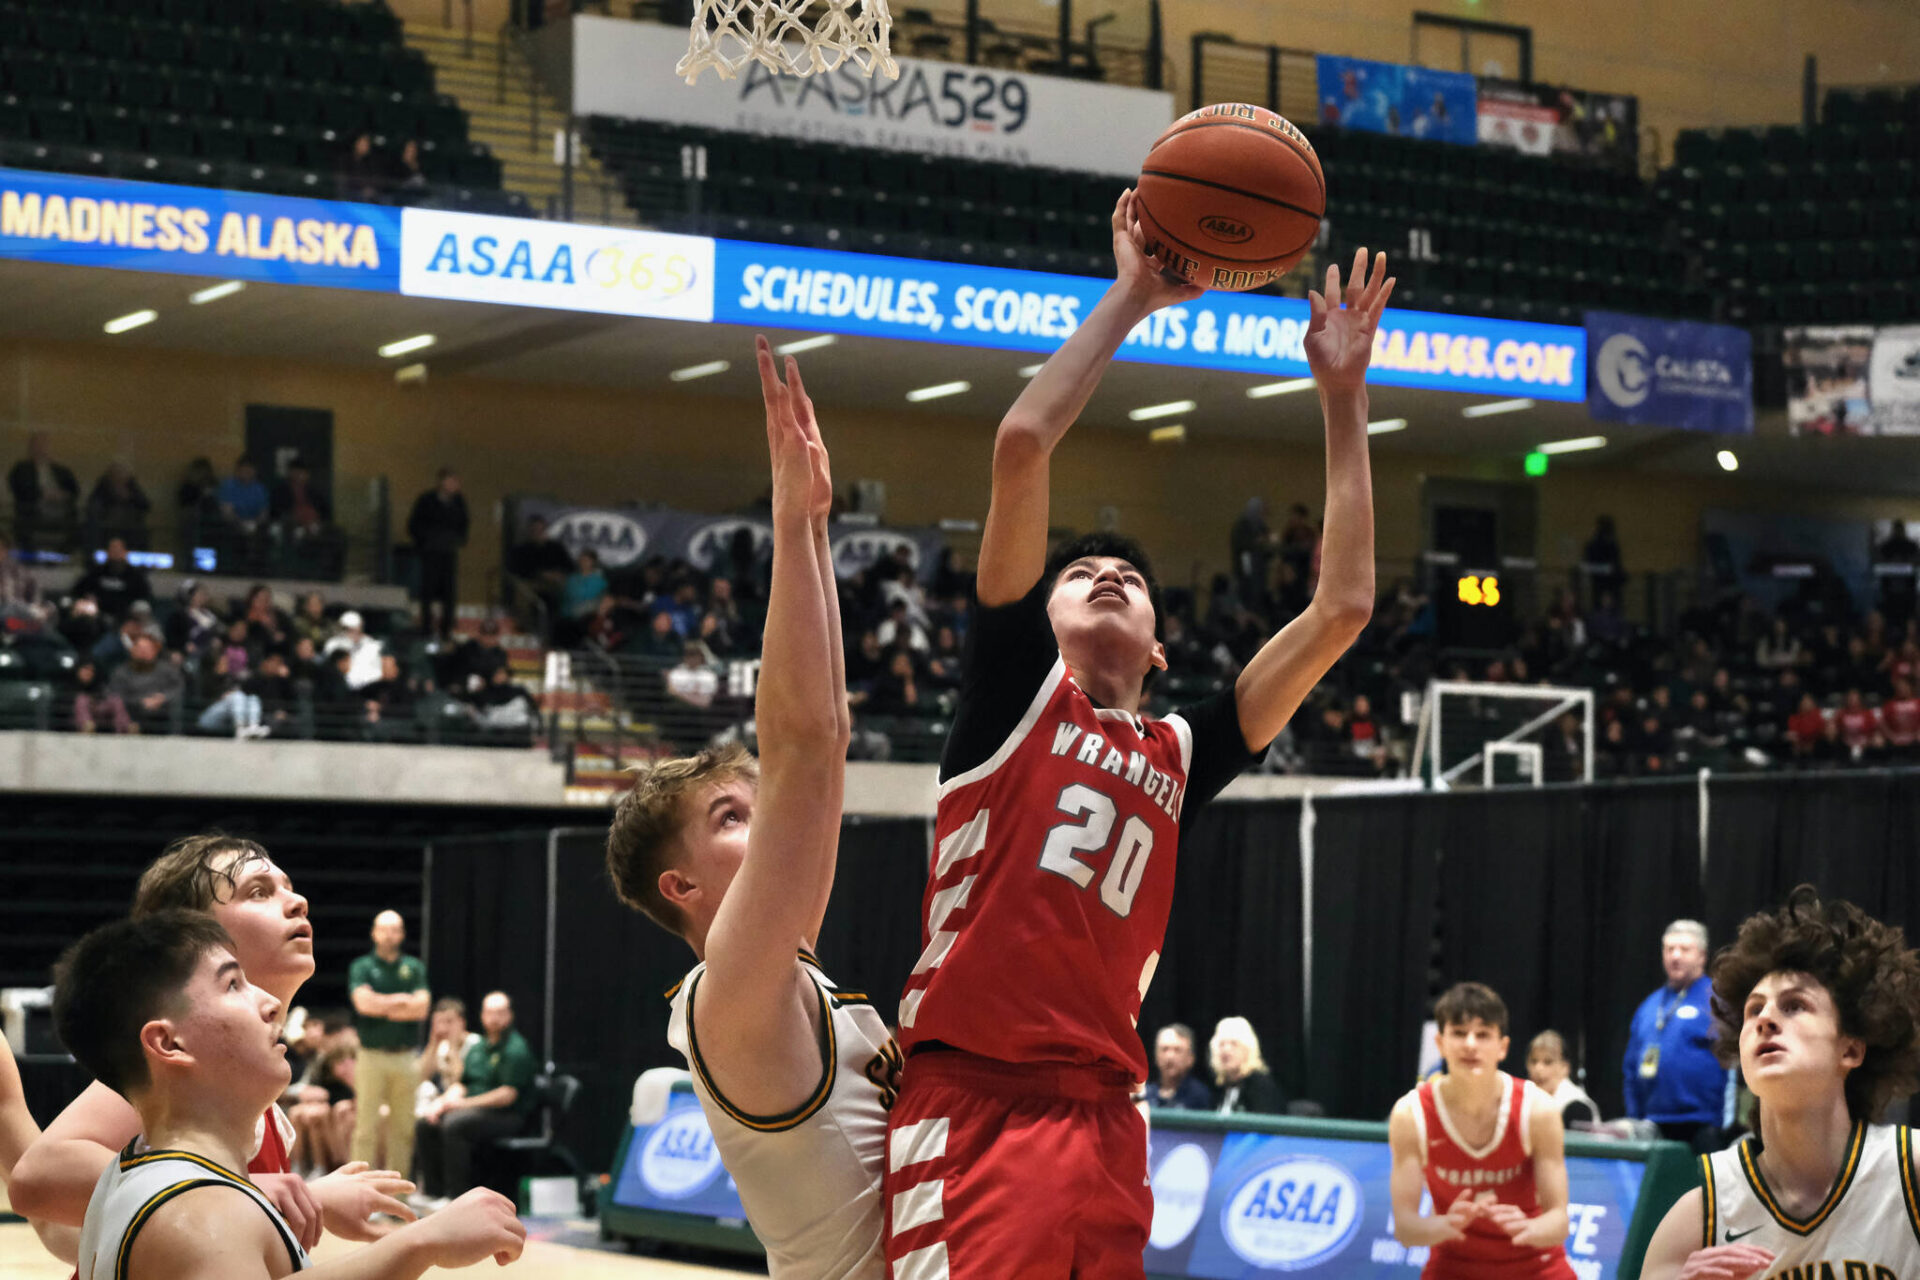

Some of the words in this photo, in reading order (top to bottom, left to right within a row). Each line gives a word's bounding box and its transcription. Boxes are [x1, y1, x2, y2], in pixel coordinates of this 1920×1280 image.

[1, 190, 210, 254] MADNESS
[216, 212, 380, 270] ALASKA
[425, 233, 576, 285] ASAA
[599, 246, 690, 295] 365
[1206, 219, 1248, 238] ASAA
[739, 263, 944, 332] SCHEDULES,
[1122, 305, 1190, 351] ATS
[1191, 309, 1220, 354] &
[1037, 782, 1154, 919] 20
[1244, 1179, 1342, 1226] ASAA
